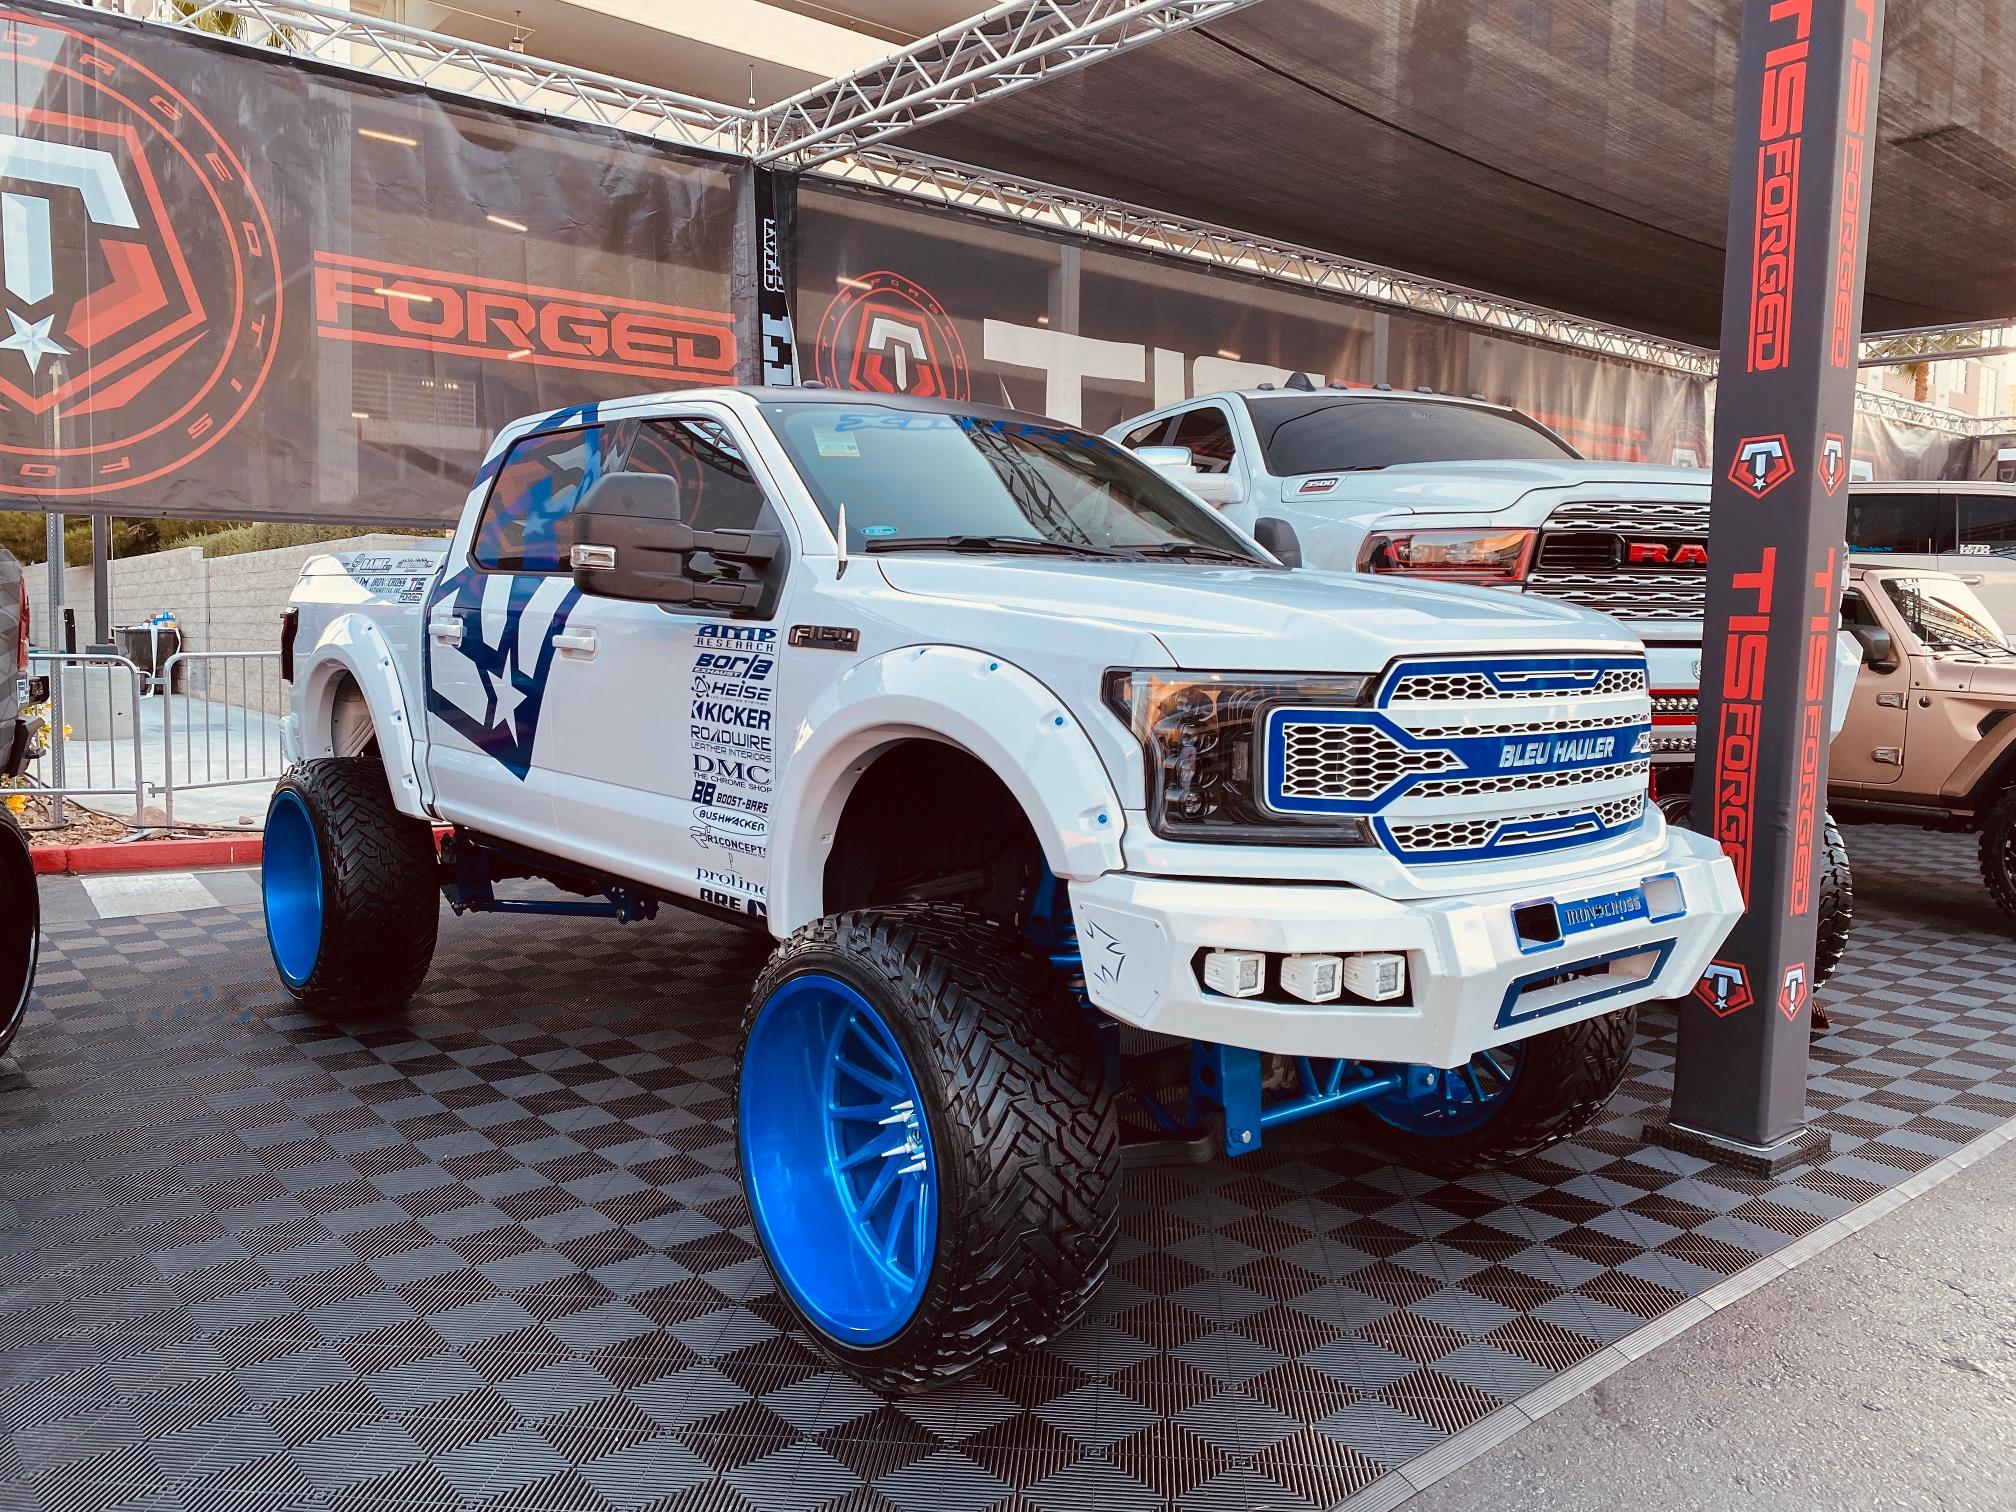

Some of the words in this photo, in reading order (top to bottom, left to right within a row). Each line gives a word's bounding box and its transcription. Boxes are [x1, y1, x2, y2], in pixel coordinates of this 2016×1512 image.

[1760, 0, 1812, 141] TIS
[1846, 0, 1875, 136] TIS
[1753, 139, 1797, 371] FORGED
[1834, 137, 1862, 367] FORGED
[314, 269, 738, 371] FORGED
[1628, 543, 1708, 563] RA
[1722, 546, 1777, 701] TIS
[1805, 547, 1836, 702] TIS
[697, 637, 774, 652] RESEARCH
[692, 667, 742, 677] EXHAUST
[704, 701, 771, 731] KICKER
[691, 725, 772, 752] ROADWIRE
[691, 741, 727, 755] LEATHER
[728, 748, 772, 763] INTERIORS
[1499, 740, 1551, 768] BLEU
[1553, 736, 1616, 763] HAULER
[692, 753, 772, 786] DMC
[694, 771, 709, 780] THE
[710, 775, 747, 789] CHROME
[748, 783, 773, 794] SHOP
[716, 792, 769, 813] BOOST-BARS
[1721, 703, 1754, 885] FORGE
[1794, 705, 1820, 914] FORGED
[699, 809, 765, 832] BUSHWACKER
[1565, 906, 1597, 925] IRON
[1604, 897, 1642, 917] CROSS
